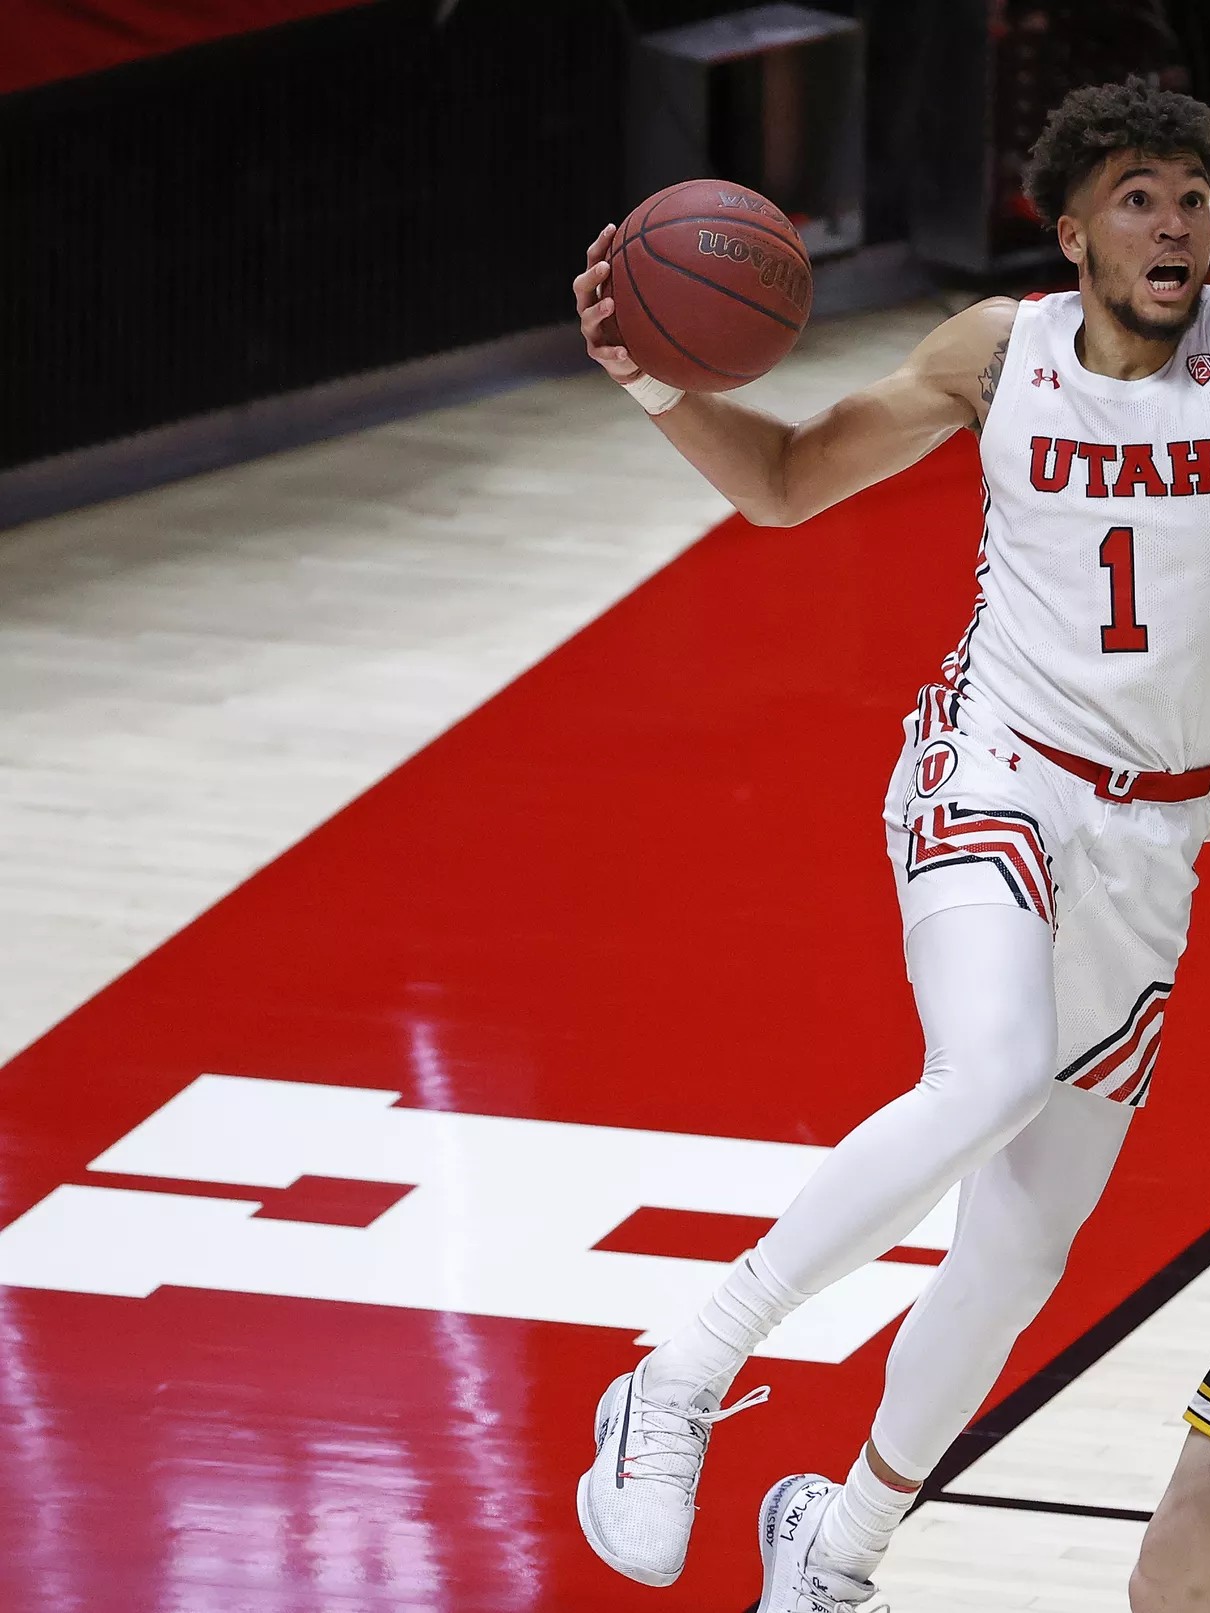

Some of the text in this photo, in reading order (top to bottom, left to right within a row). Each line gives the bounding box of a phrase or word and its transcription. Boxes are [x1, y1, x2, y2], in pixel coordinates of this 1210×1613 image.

[698, 230, 811, 312] Wilson
[1099, 526, 1149, 654] 1
[921, 751, 950, 782] U
[1107, 766, 1141, 798] U
